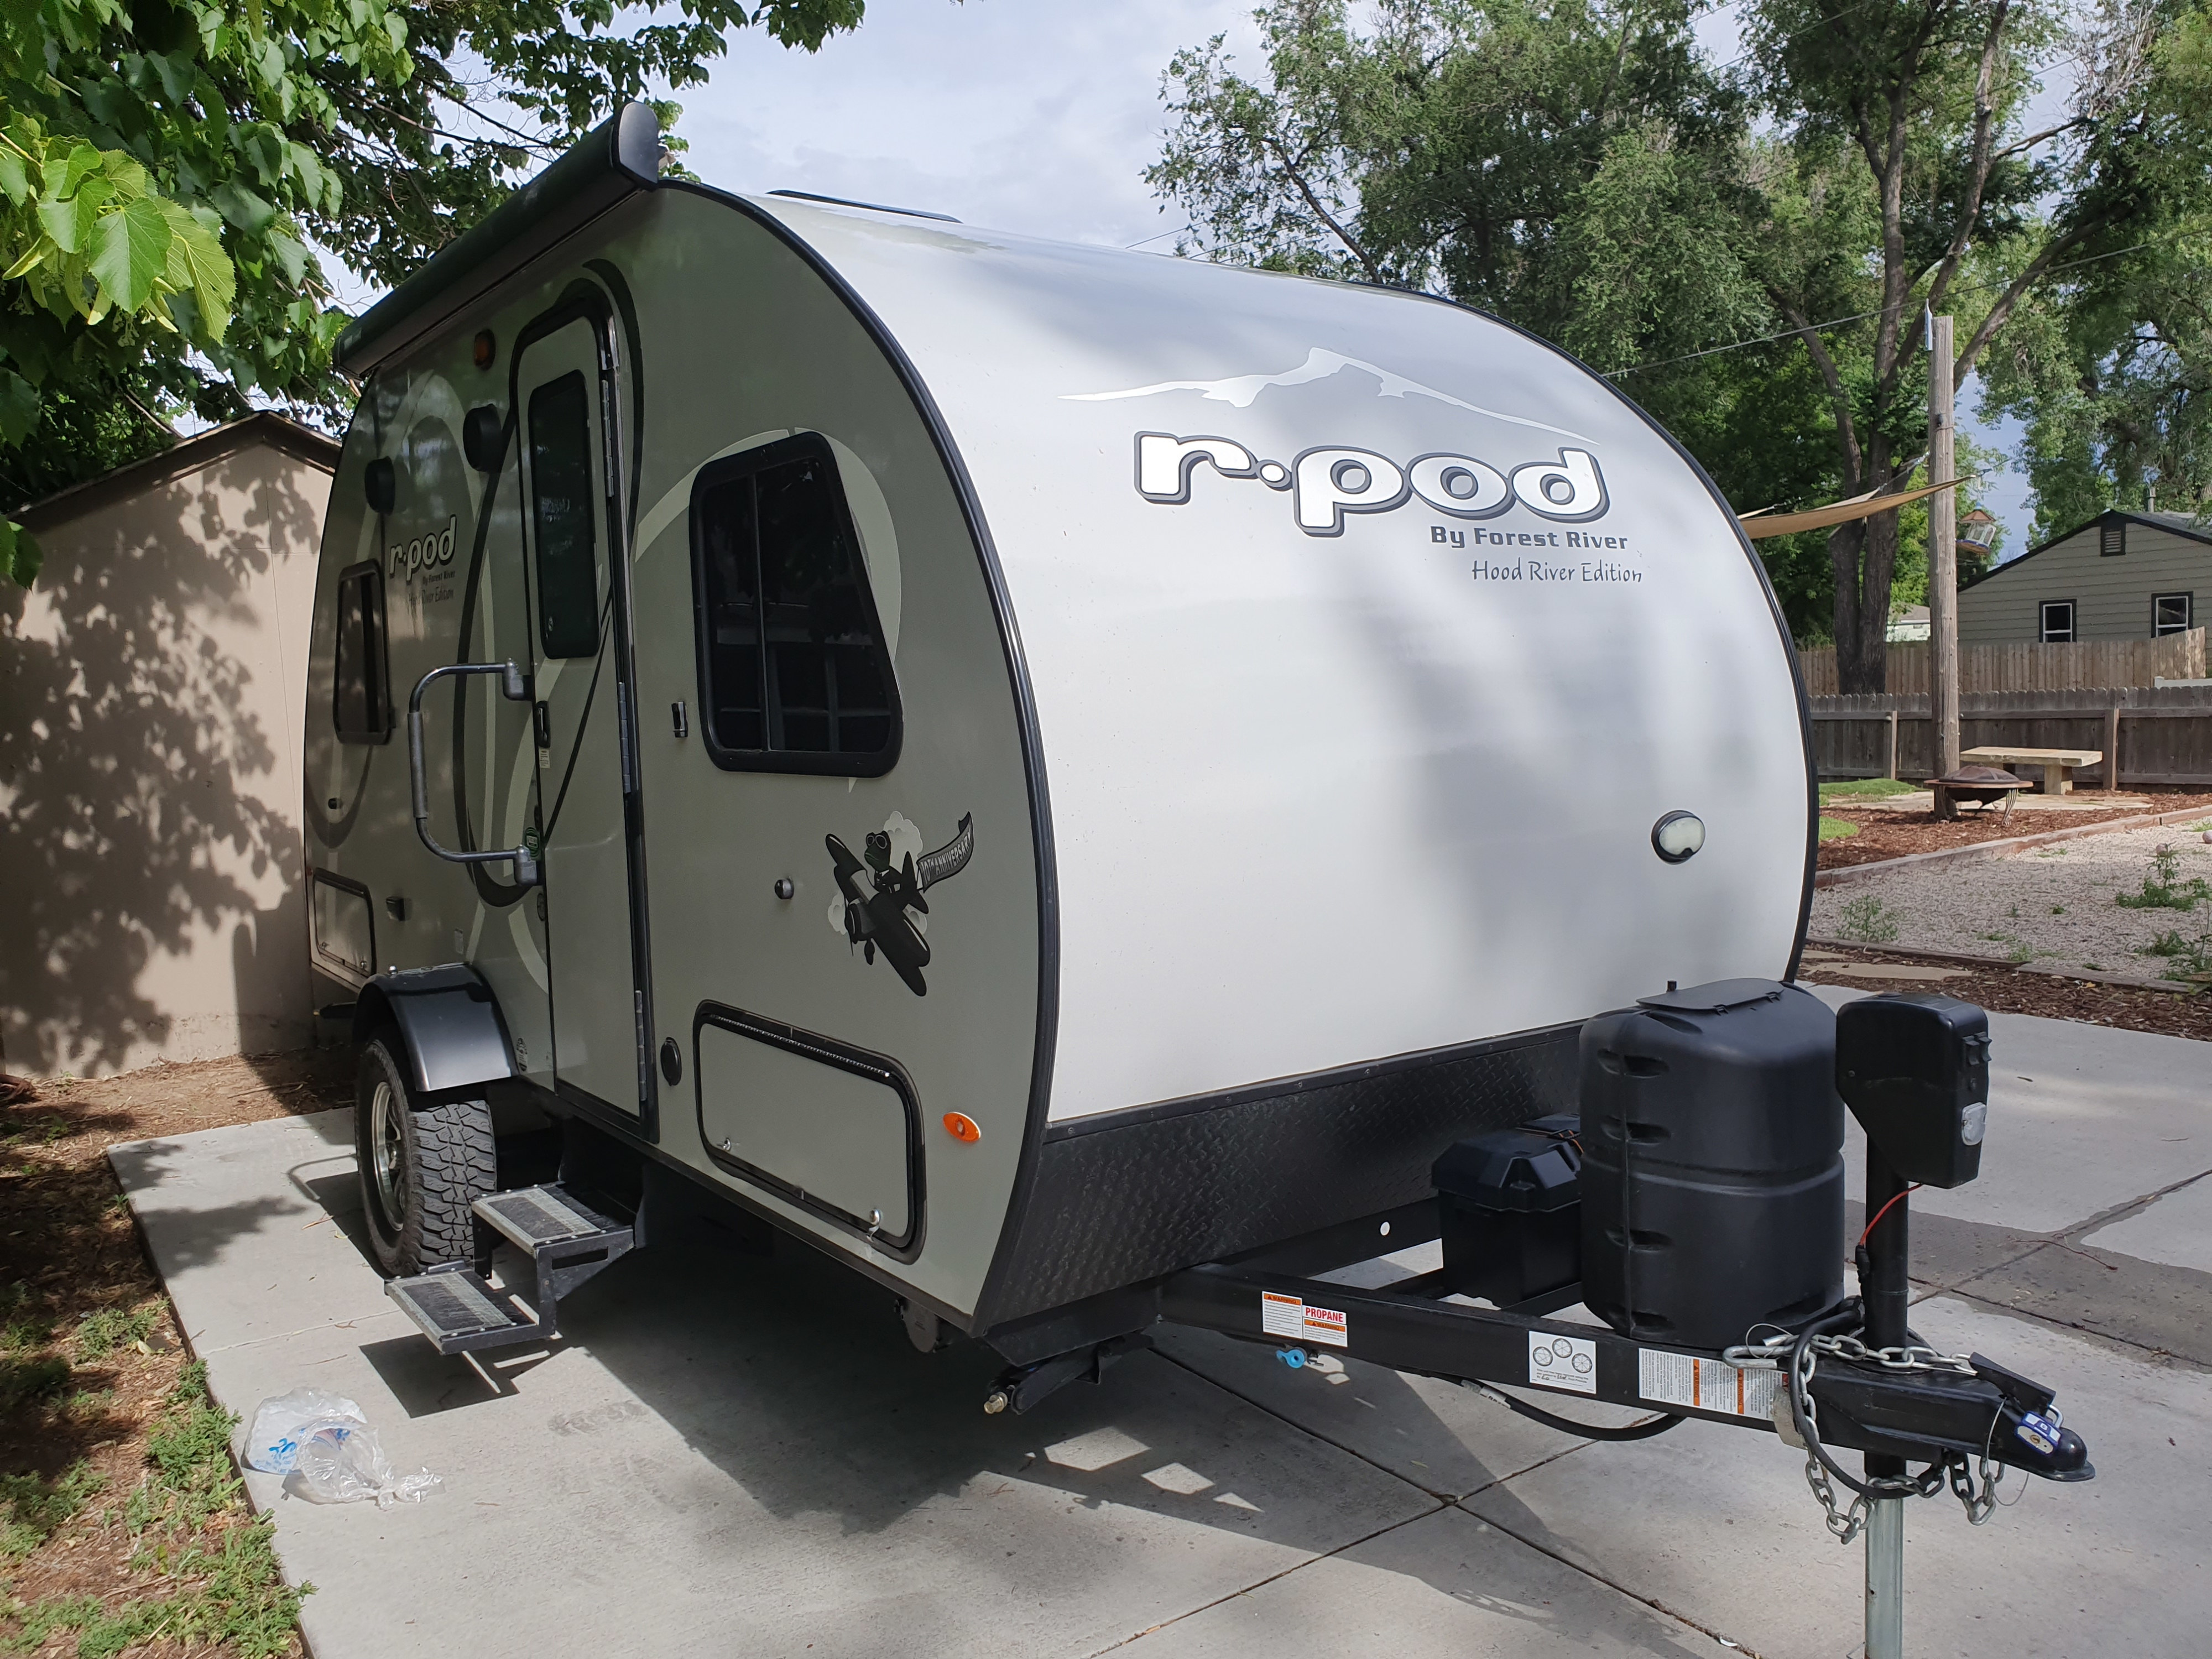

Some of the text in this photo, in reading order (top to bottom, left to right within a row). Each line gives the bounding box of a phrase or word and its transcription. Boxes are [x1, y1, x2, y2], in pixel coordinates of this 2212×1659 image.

[1431, 526, 1628, 549] By Forest River
[1472, 557, 1642, 582] Hood River Edition
[935, 828, 972, 875] ANNIVERSARY
[1306, 1307, 1344, 1322] PROPANE
